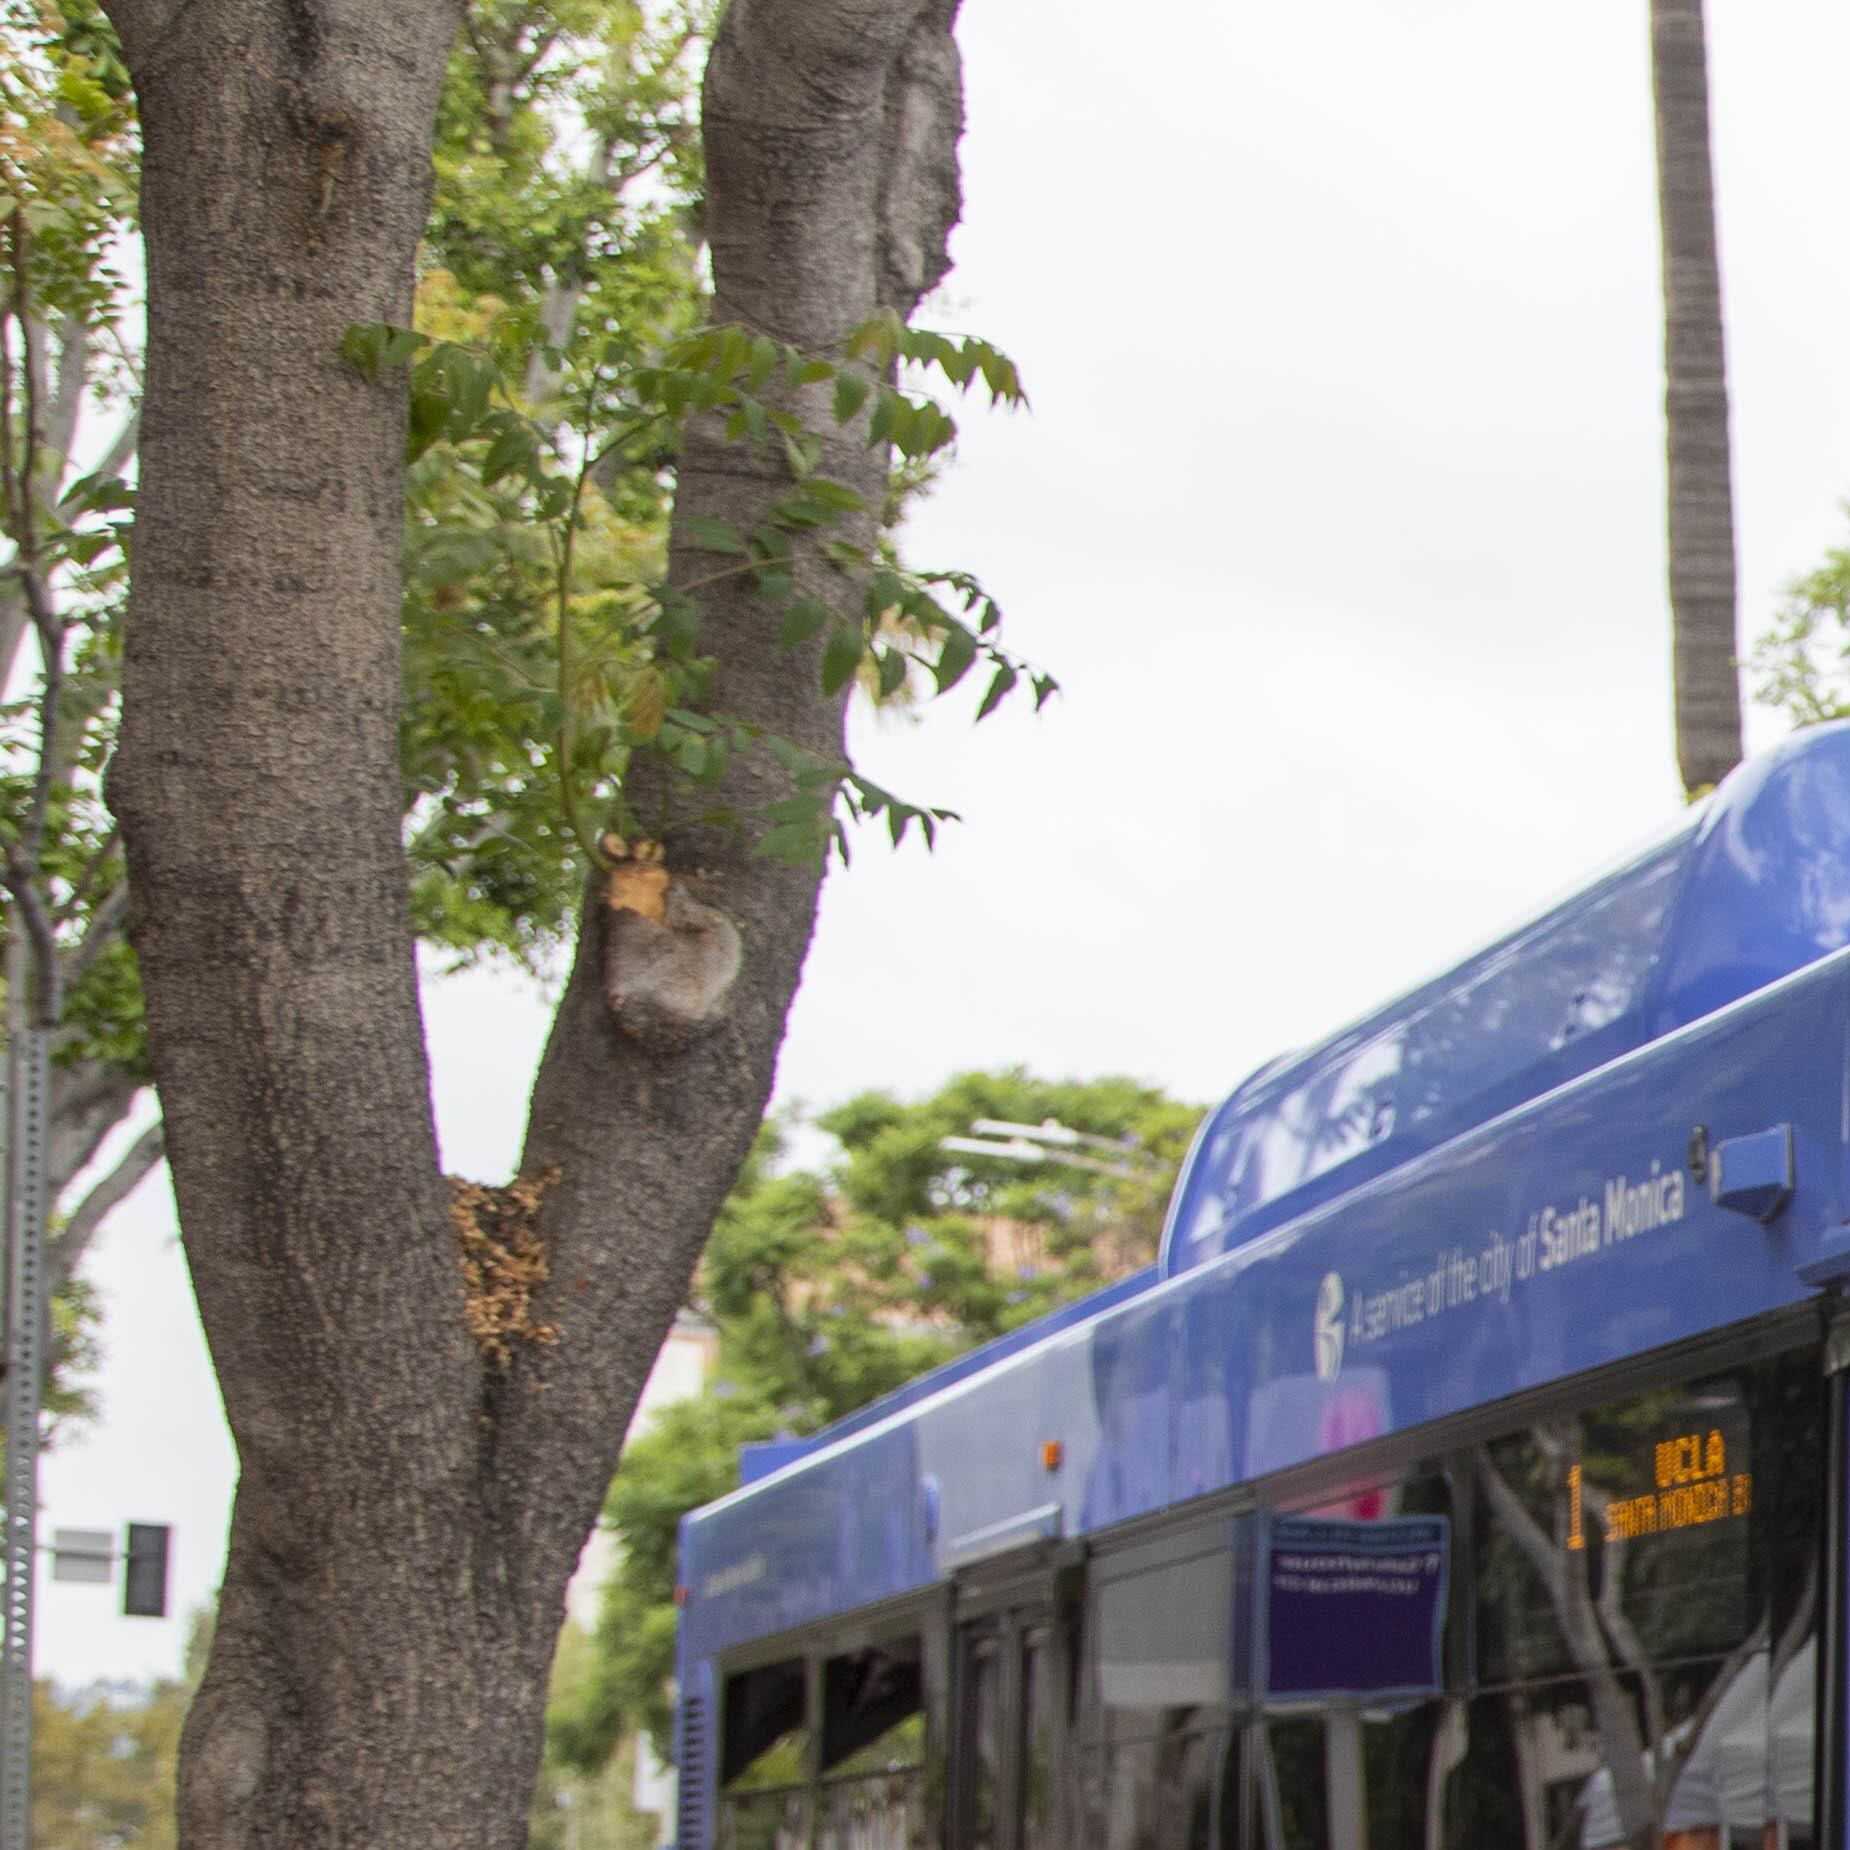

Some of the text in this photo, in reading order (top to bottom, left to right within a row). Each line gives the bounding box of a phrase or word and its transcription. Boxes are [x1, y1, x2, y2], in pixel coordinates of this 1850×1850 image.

[1364, 1271, 1425, 1341] service
[1449, 1244, 1478, 1307] the
[1479, 1230, 1516, 1304] city
[1516, 1215, 1539, 1281] of
[1539, 1196, 1601, 1271] Santa
[1603, 1159, 1685, 1245] Monica
[1655, 1428, 1725, 1488] UCLA
[1567, 1464, 1585, 1550] 1
